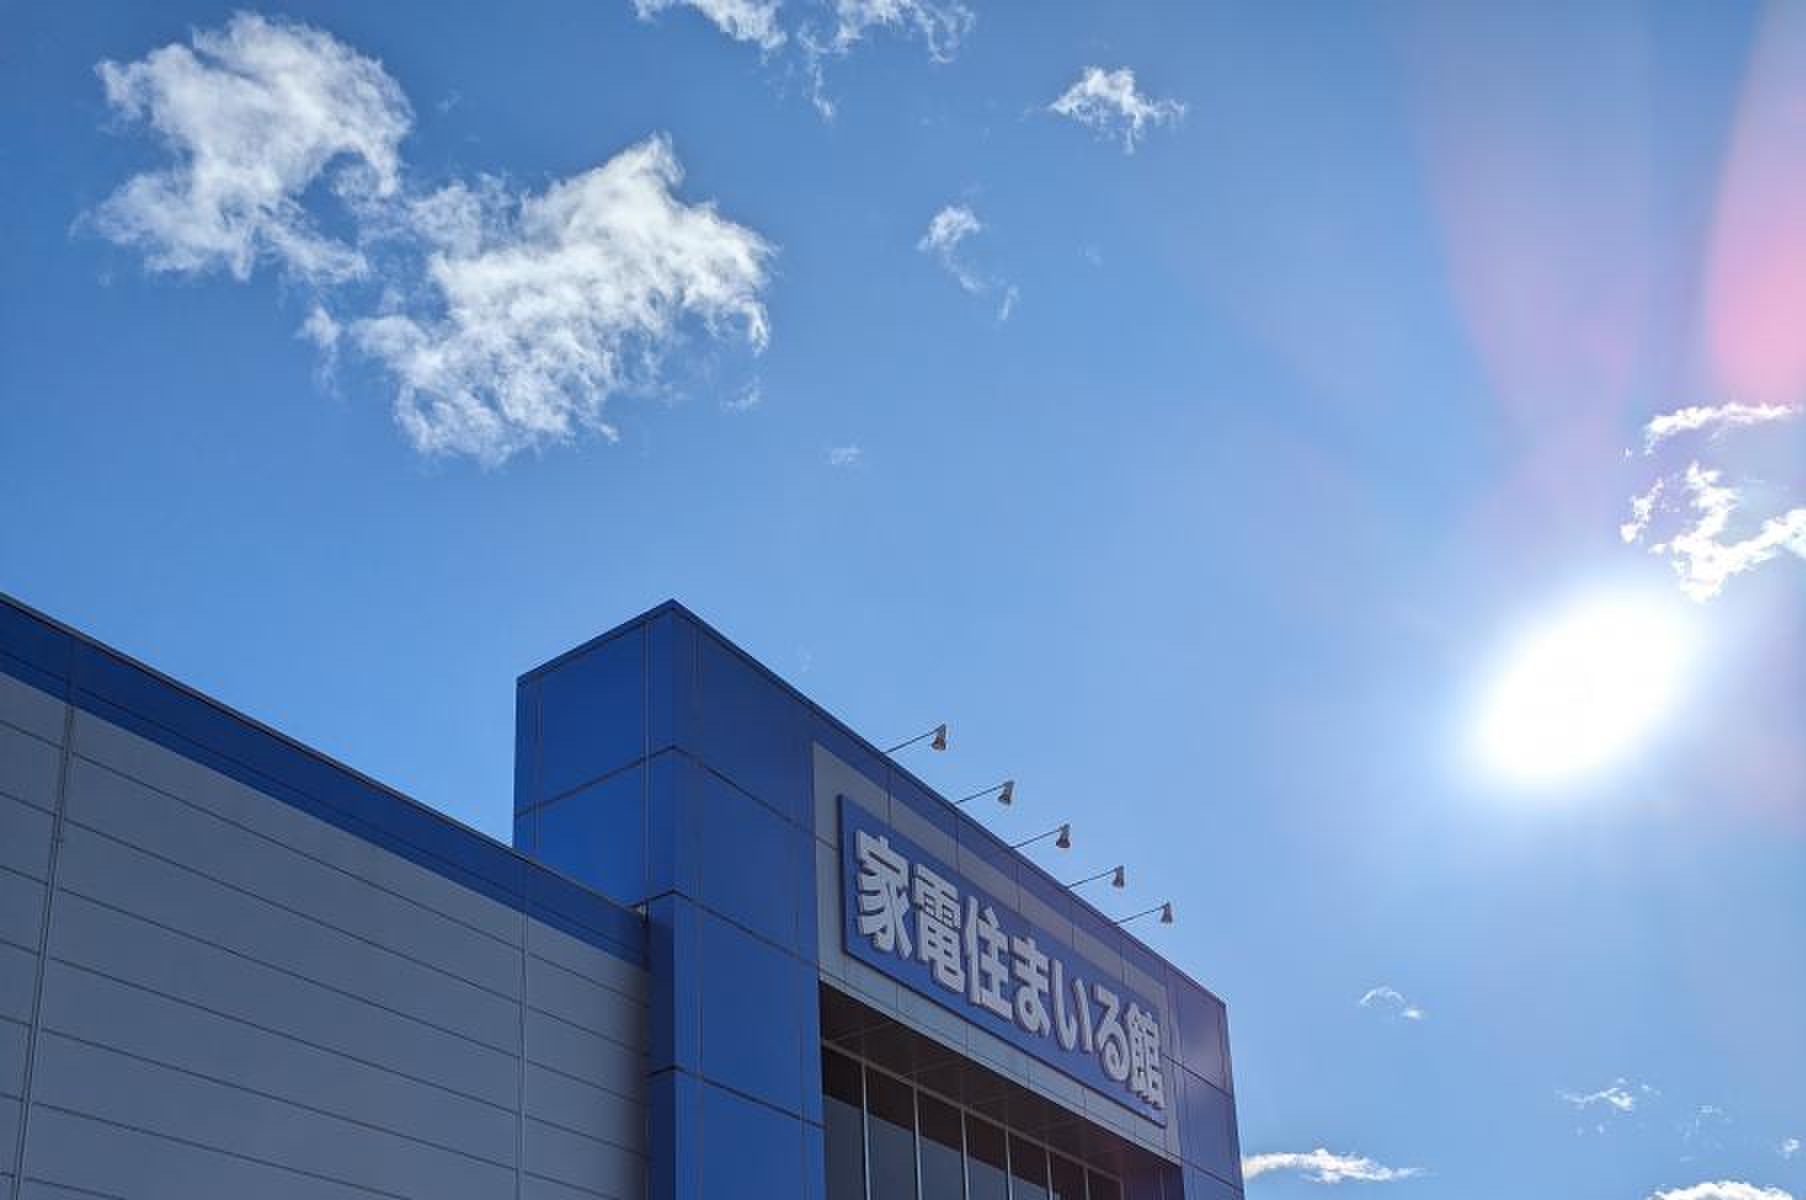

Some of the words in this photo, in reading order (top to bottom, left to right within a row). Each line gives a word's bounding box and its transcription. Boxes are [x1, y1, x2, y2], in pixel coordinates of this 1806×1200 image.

[856, 830, 1166, 1110] 家電住まいる館
